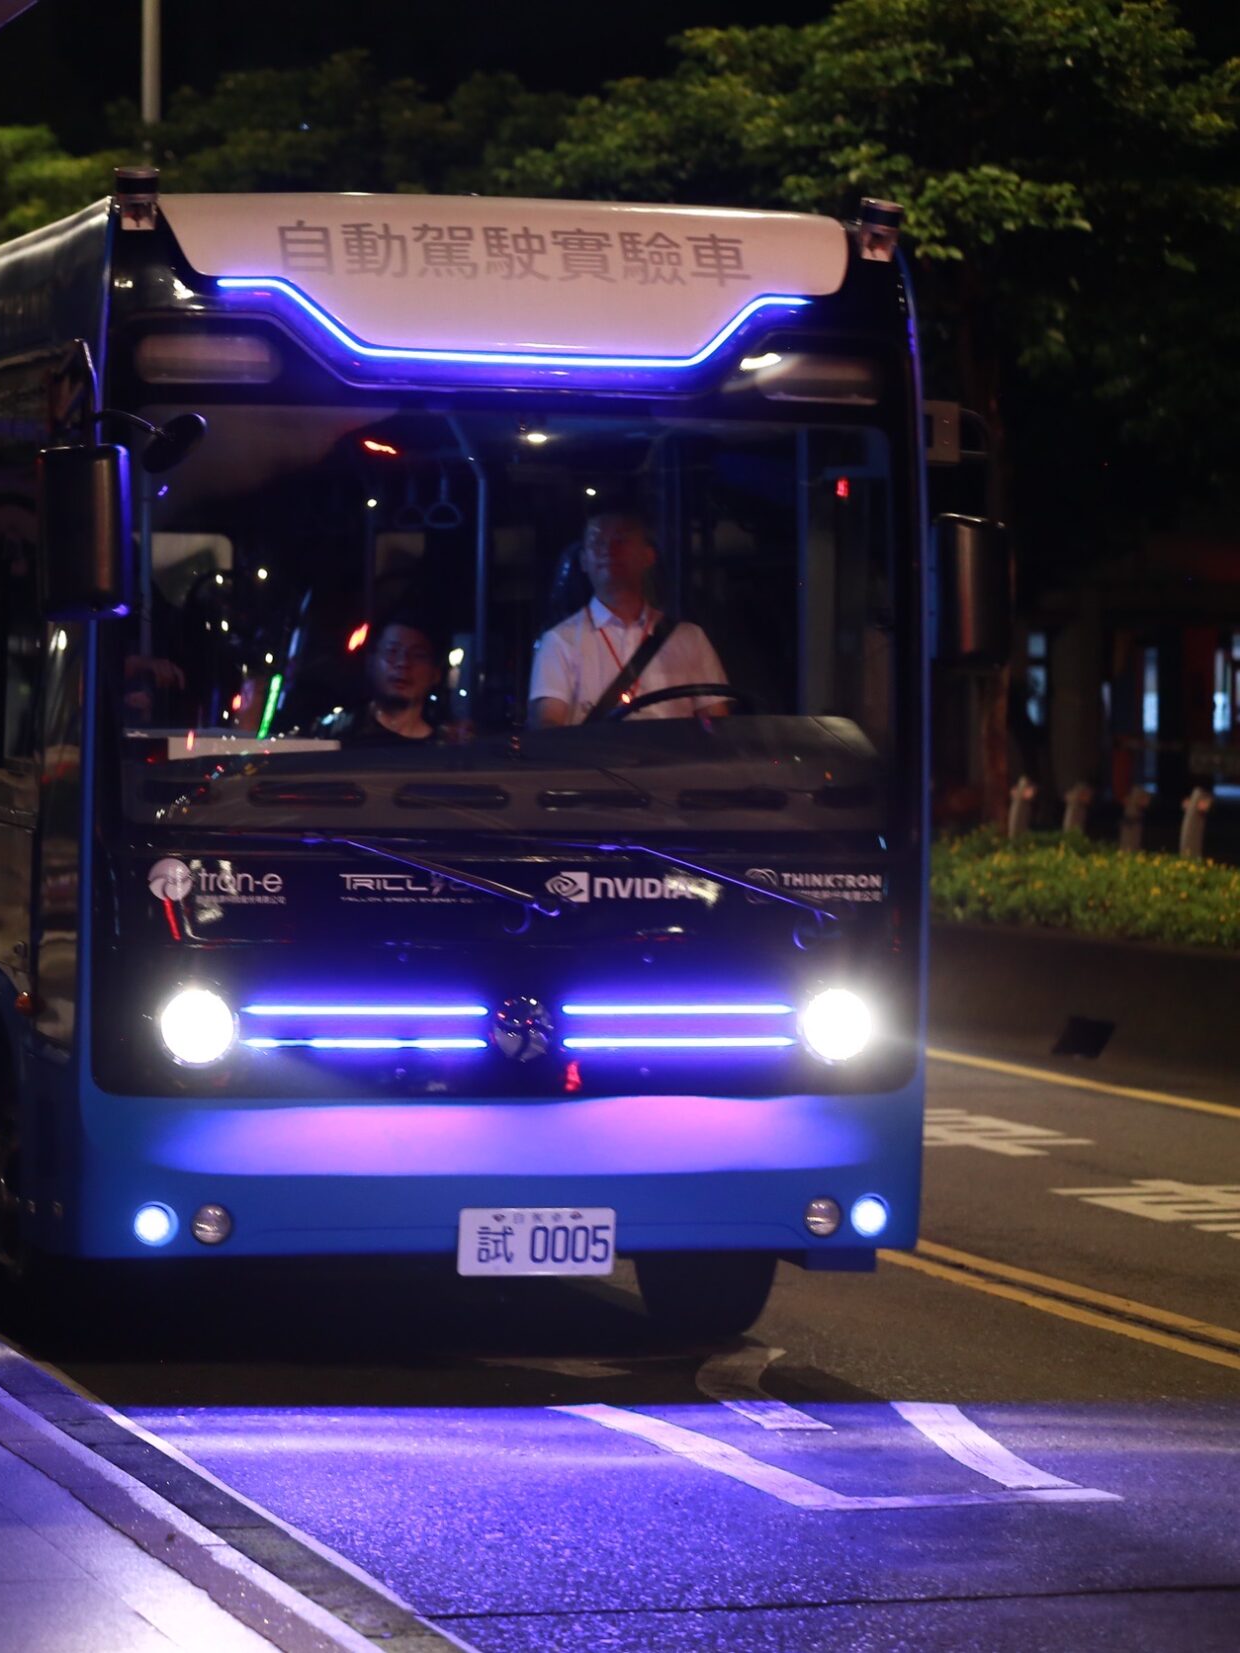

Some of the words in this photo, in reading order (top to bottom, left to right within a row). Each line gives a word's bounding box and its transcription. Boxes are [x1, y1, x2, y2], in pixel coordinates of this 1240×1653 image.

[277, 219, 752, 287] 自動駕駛實驗車
[198, 867, 283, 893] tron-e
[781, 872, 883, 889] THINKTRON
[477, 1226, 514, 1263] 試
[530, 1225, 610, 1263] 0005
